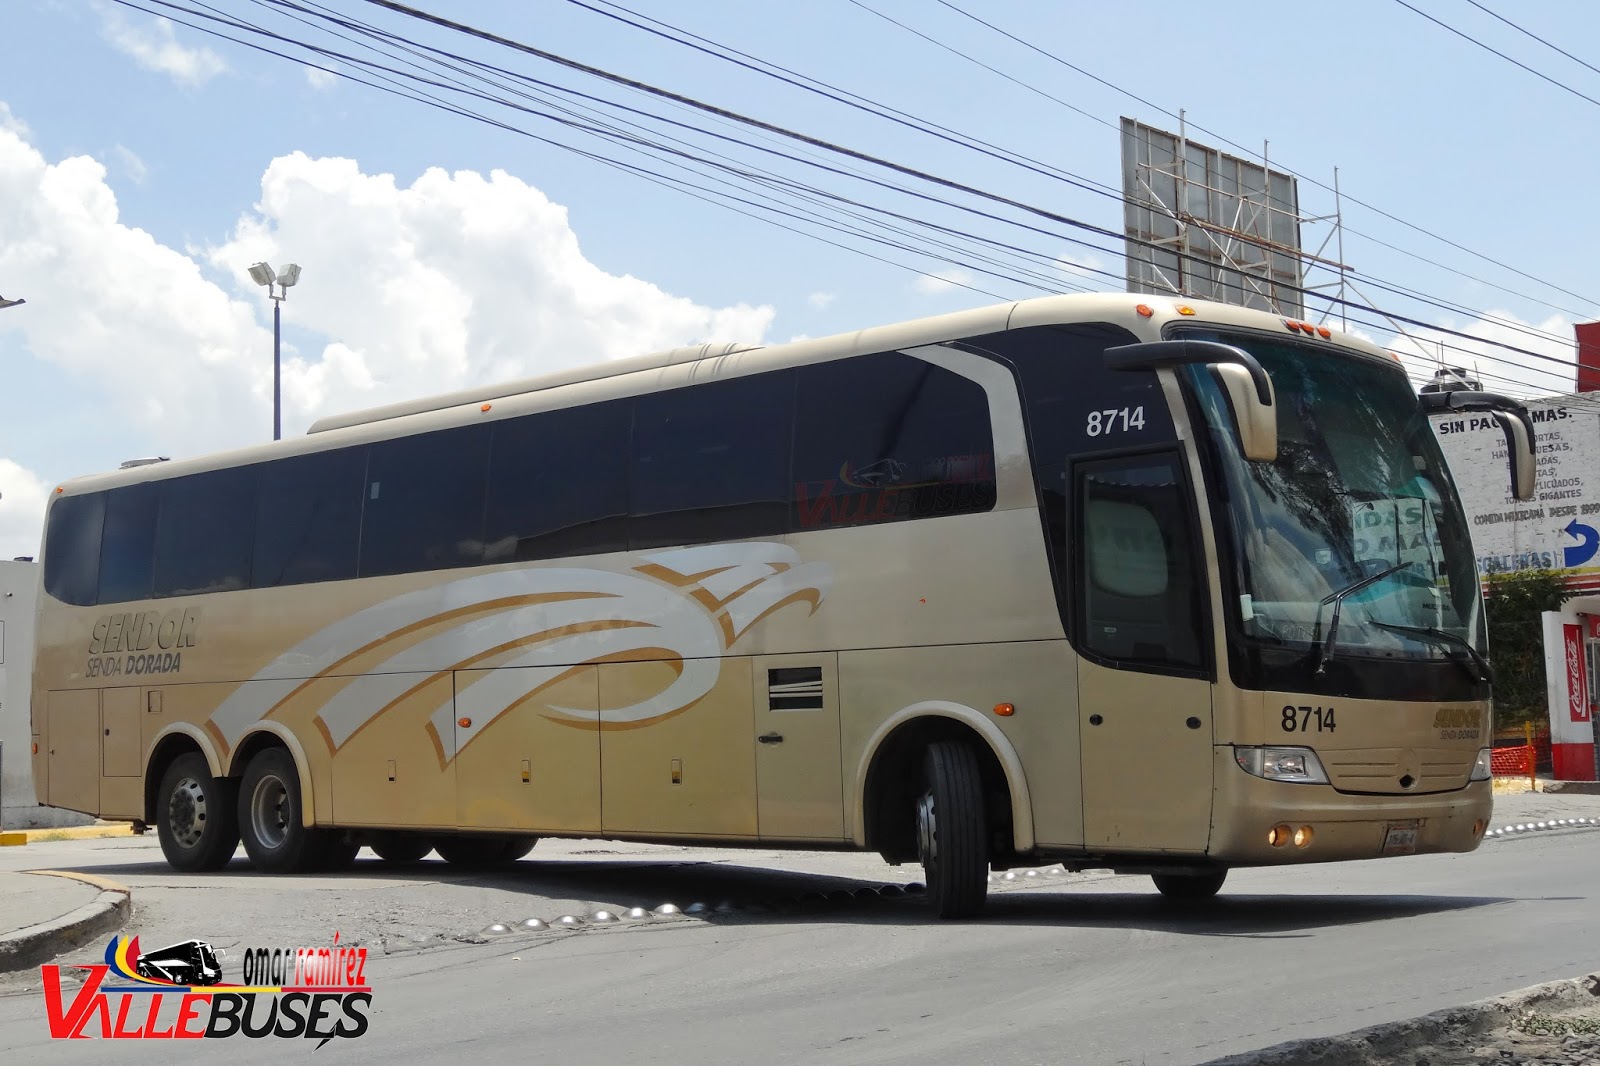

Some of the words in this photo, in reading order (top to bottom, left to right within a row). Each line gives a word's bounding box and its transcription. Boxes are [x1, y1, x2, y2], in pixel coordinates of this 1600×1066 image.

[1087, 406, 1145, 437] 8714
[1439, 420, 1465, 434] SIN
[1532, 407, 1573, 423] MAS.
[1540, 489, 1582, 501] GIGANTES
[1474, 513, 1503, 526] COMIDA
[1504, 507, 1545, 523] MEXICANA
[1549, 505, 1577, 518] DESDE
[88, 606, 202, 654] SENDOR
[85, 657, 121, 678] SENDA
[125, 653, 181, 675] DORADA
[1281, 706, 1336, 733] 8714
[1433, 708, 1481, 729] SENDOR
